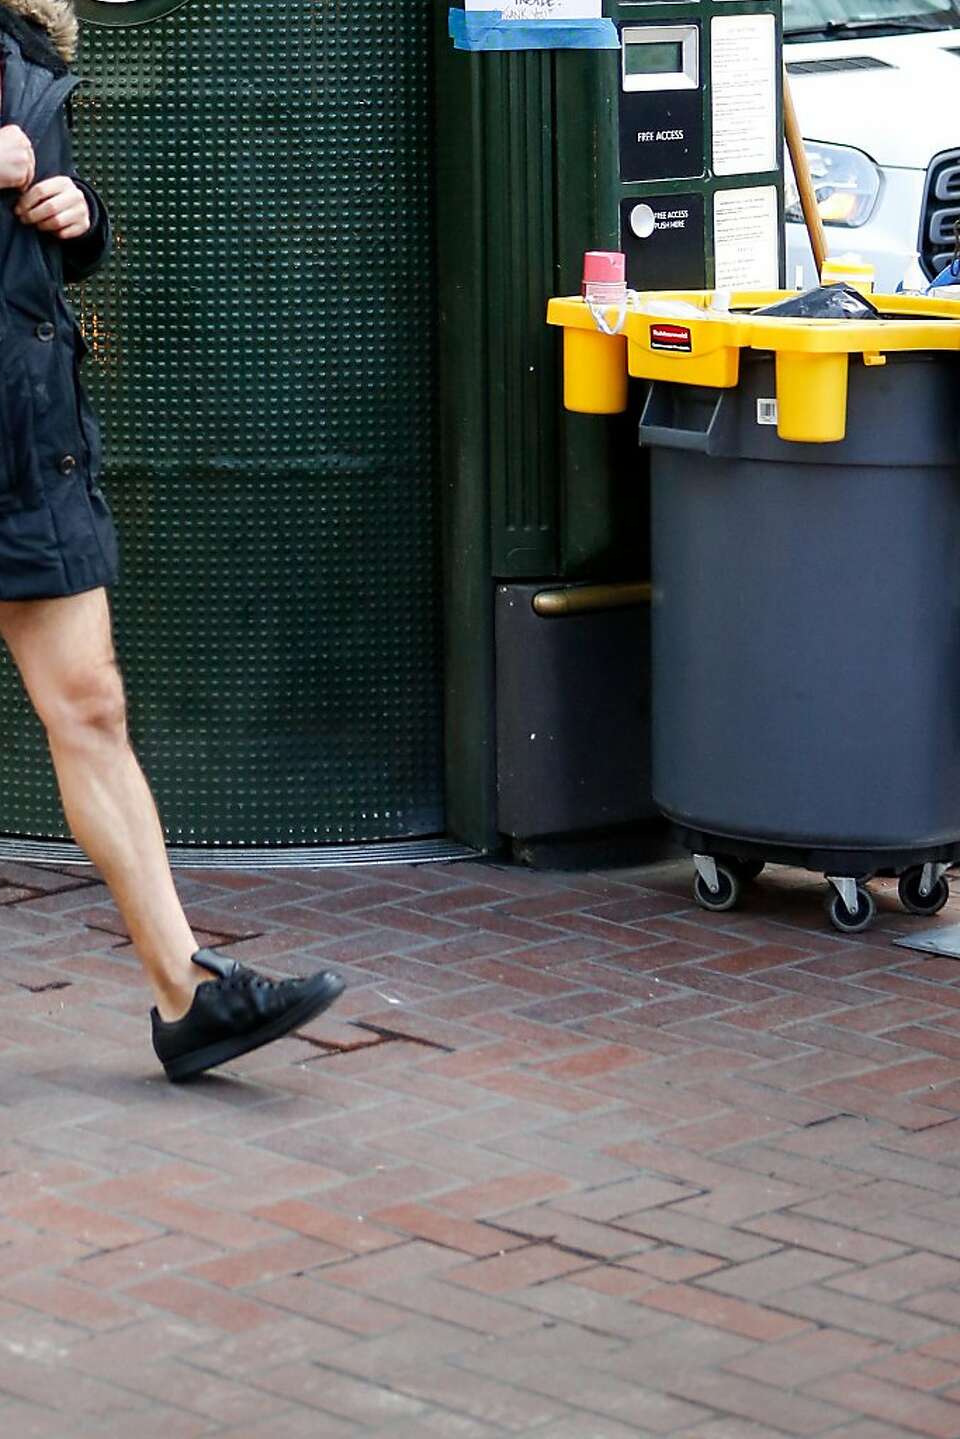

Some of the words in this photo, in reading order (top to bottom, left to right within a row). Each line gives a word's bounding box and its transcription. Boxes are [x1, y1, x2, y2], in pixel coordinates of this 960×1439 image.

[637, 131, 654, 142] FREE
[656, 129, 684, 141] ACCESS
[667, 209, 689, 219] ACCESS
